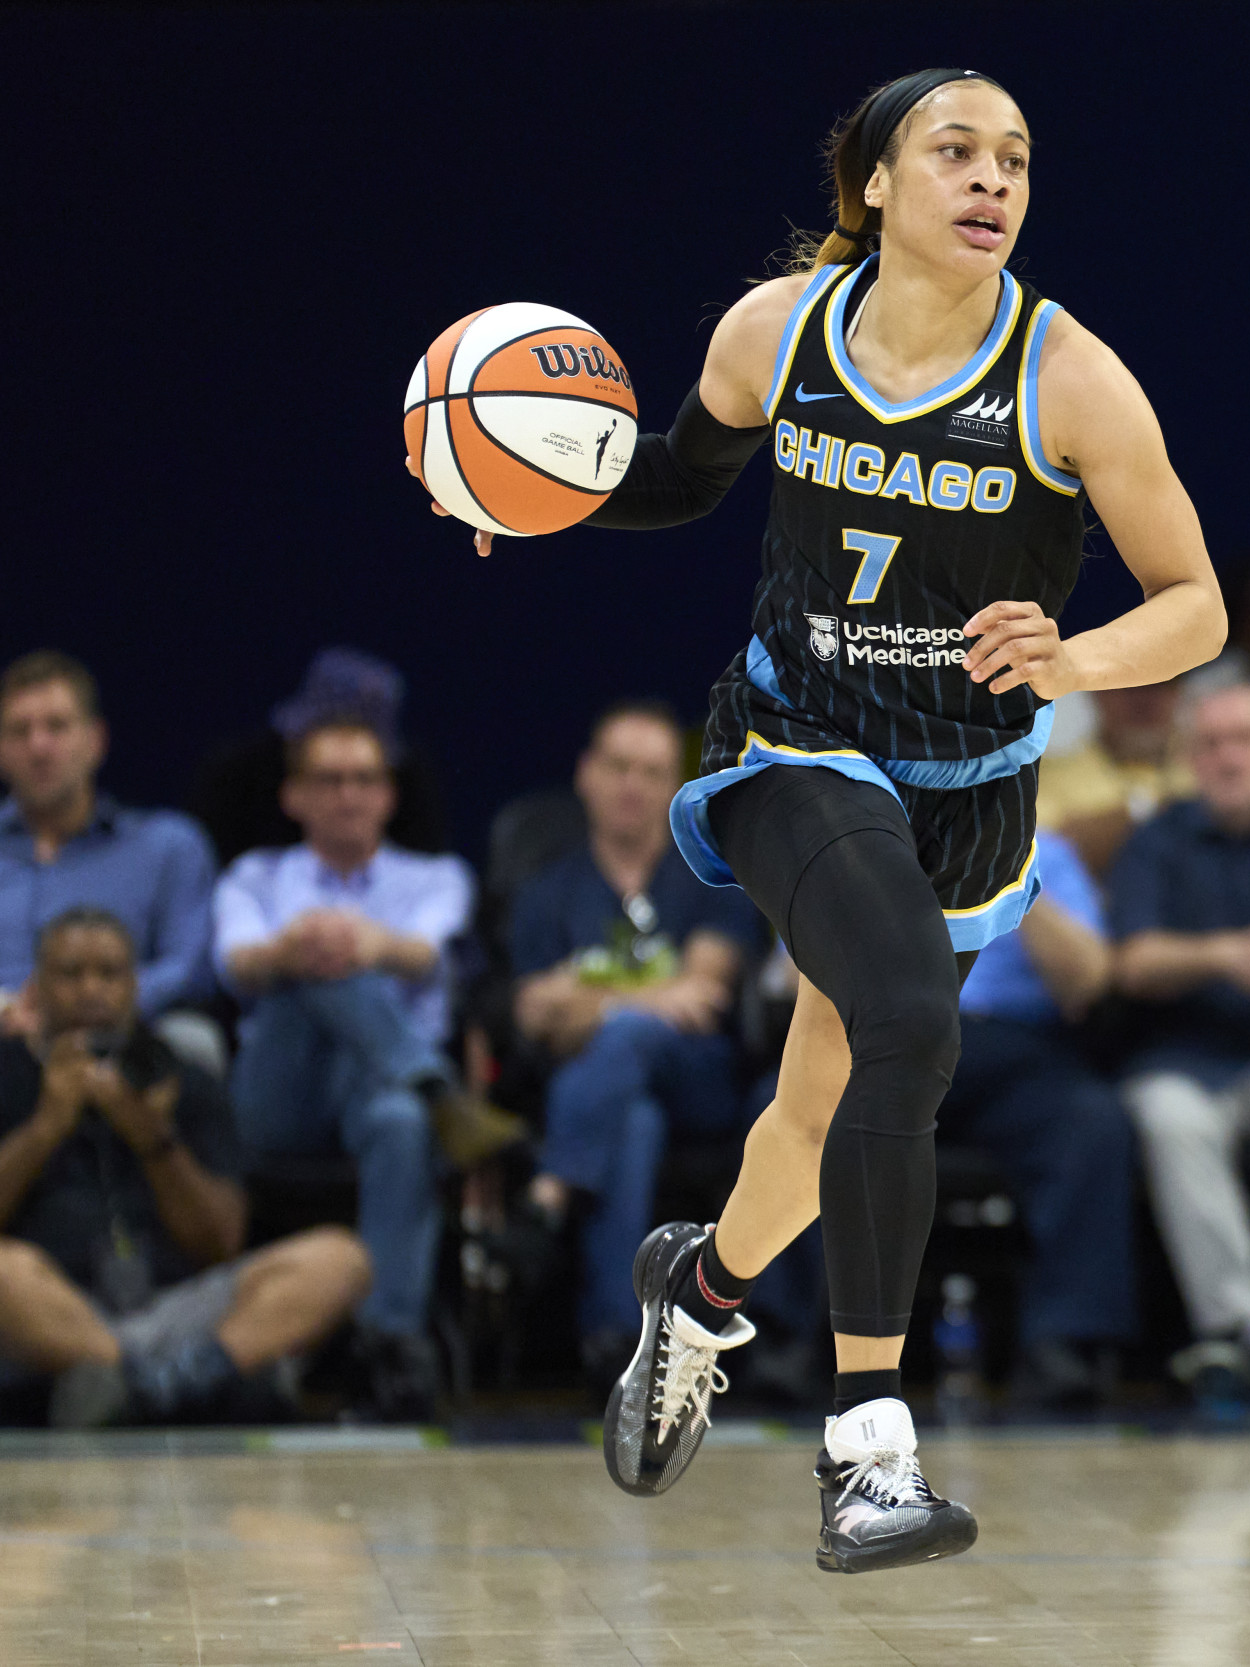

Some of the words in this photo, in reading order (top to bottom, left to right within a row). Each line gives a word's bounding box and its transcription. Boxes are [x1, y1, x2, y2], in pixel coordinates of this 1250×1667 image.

[529, 343, 635, 394] Wilso
[950, 417, 1008, 436] MAGELLAN
[541, 437, 565, 449] GAME
[566, 445, 585, 455] BALL
[549, 432, 583, 447] OFFICIAL
[774, 418, 1017, 514] CHICAGO
[841, 527, 902, 605] 7
[846, 643, 967, 668] Medicine
